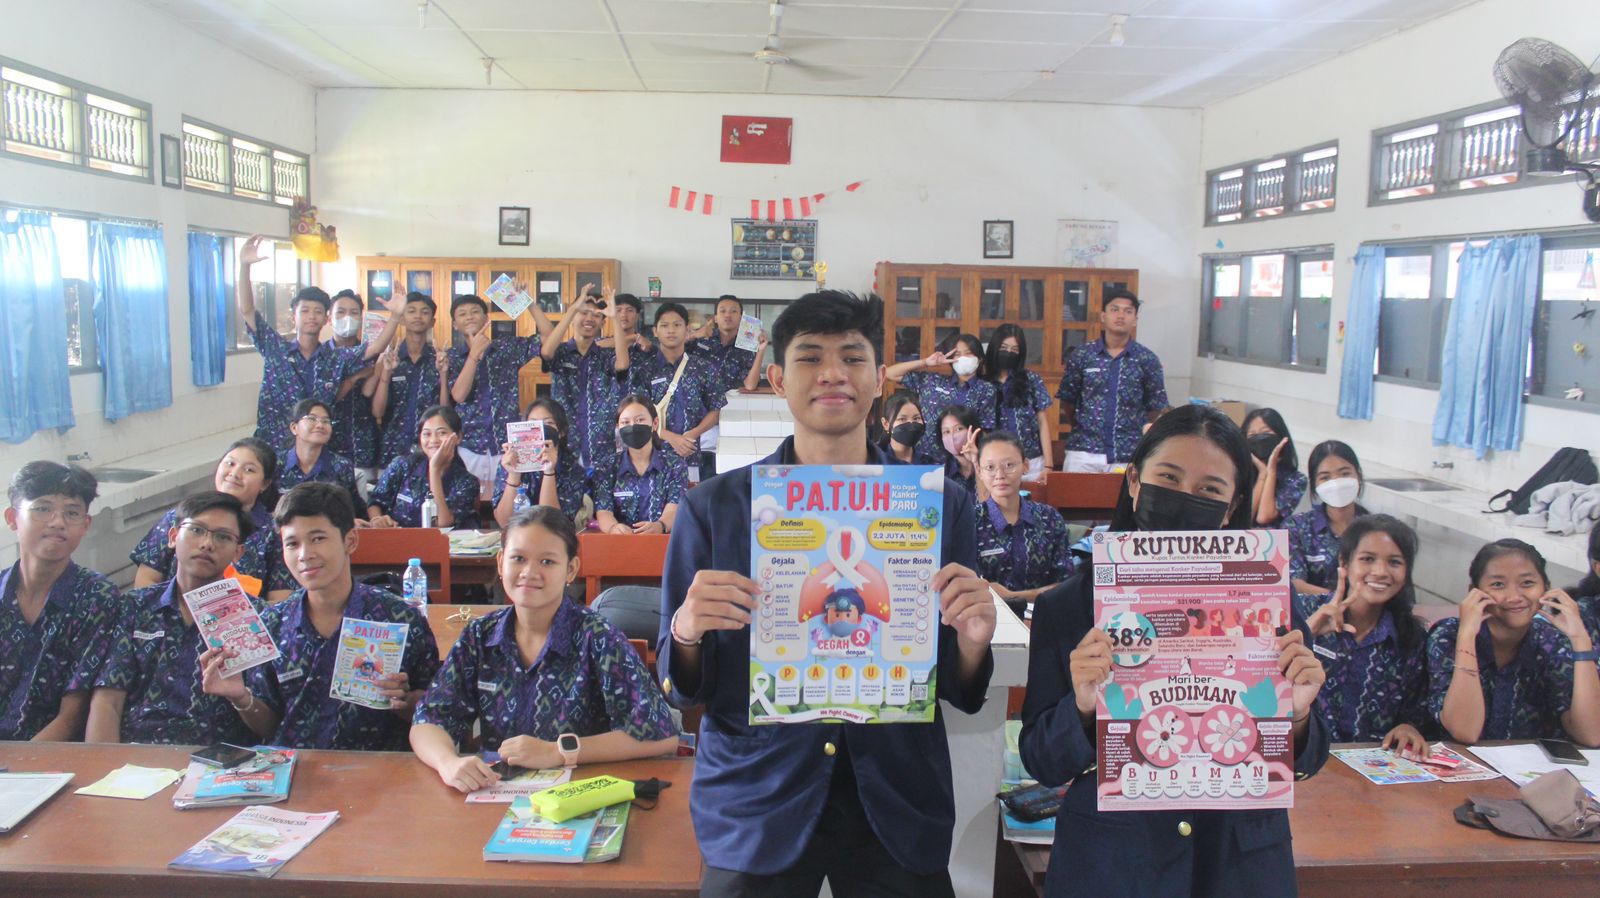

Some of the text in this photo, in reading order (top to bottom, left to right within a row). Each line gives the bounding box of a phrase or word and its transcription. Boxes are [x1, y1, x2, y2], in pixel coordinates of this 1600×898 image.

[787, 480, 890, 512] P.A.T.U.H
[892, 490, 919, 500] Kanker
[892, 500, 918, 510] PARU
[1132, 536, 1249, 556] KUTUKAPA
[771, 557, 796, 568] Gejala
[1107, 627, 1152, 646] 38%
[817, 640, 849, 650] CEGAH
[784, 668, 791, 678] P
[812, 668, 819, 676] A
[840, 666, 847, 676] T
[868, 666, 874, 676] U
[895, 666, 902, 676] H
[1168, 674, 1216, 684] Mari ber-
[1149, 685, 1237, 706] BUDIMAN
[1128, 766, 1263, 781] B U D I M A N
